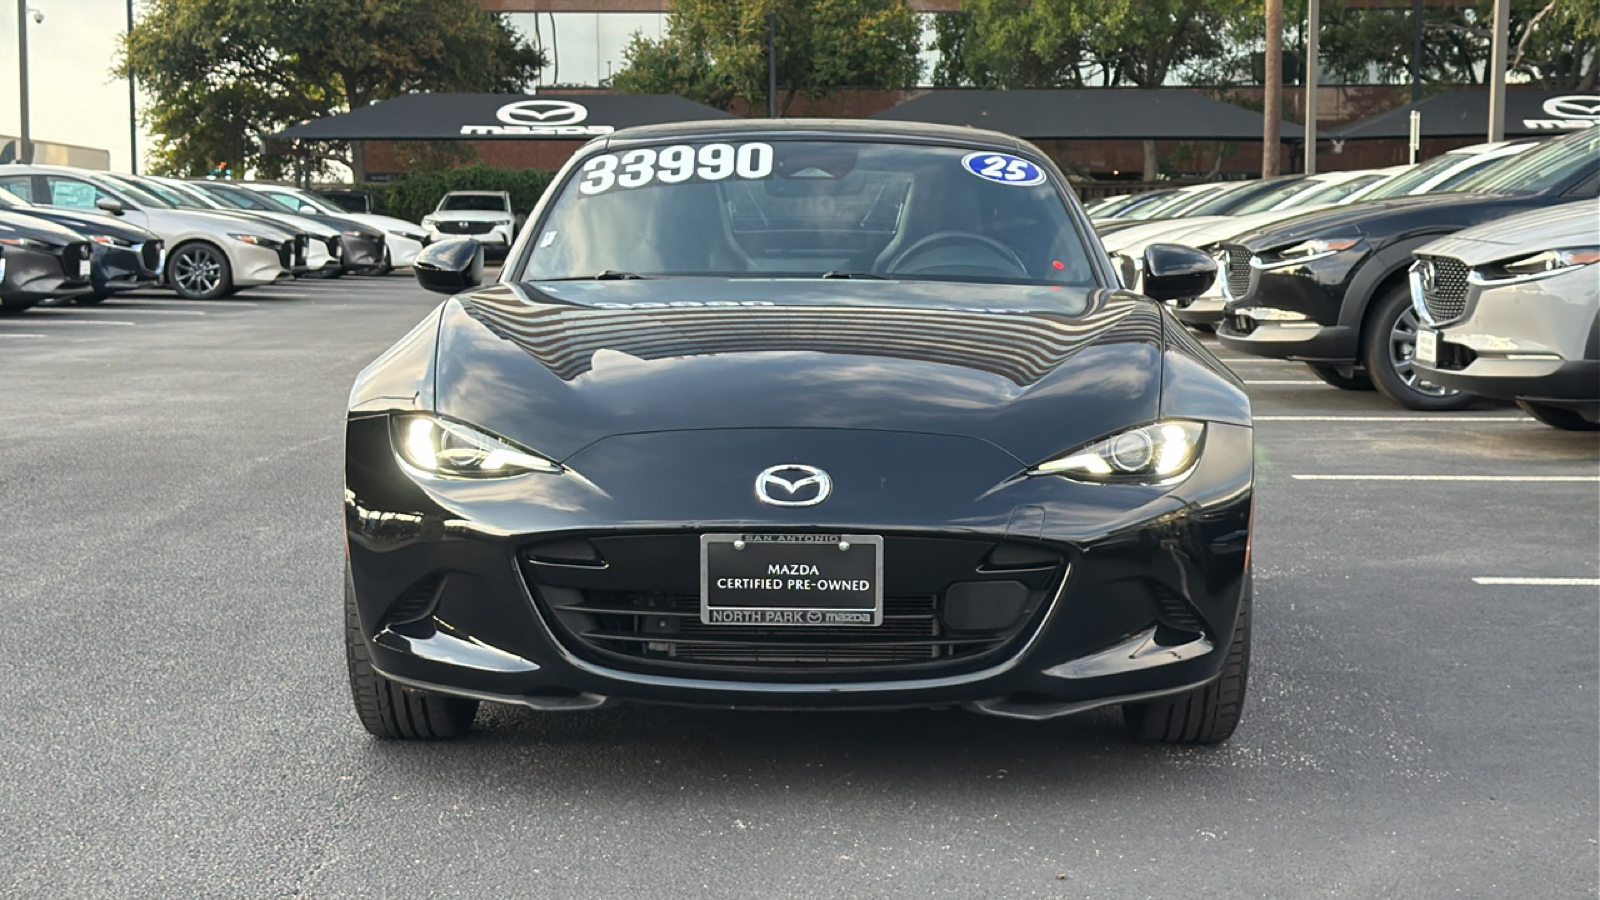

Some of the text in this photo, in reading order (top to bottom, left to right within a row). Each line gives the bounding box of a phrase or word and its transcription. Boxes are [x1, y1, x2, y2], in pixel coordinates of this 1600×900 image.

[579, 142, 773, 195] 33990
[980, 156, 1028, 181] 25
[745, 534, 839, 542] SAN ANTONIO
[768, 564, 819, 575] MAZDA
[717, 578, 870, 591] CERTIFIED PRE-OWNED
[712, 610, 762, 622] NORTH
[765, 611, 803, 622] PARK
